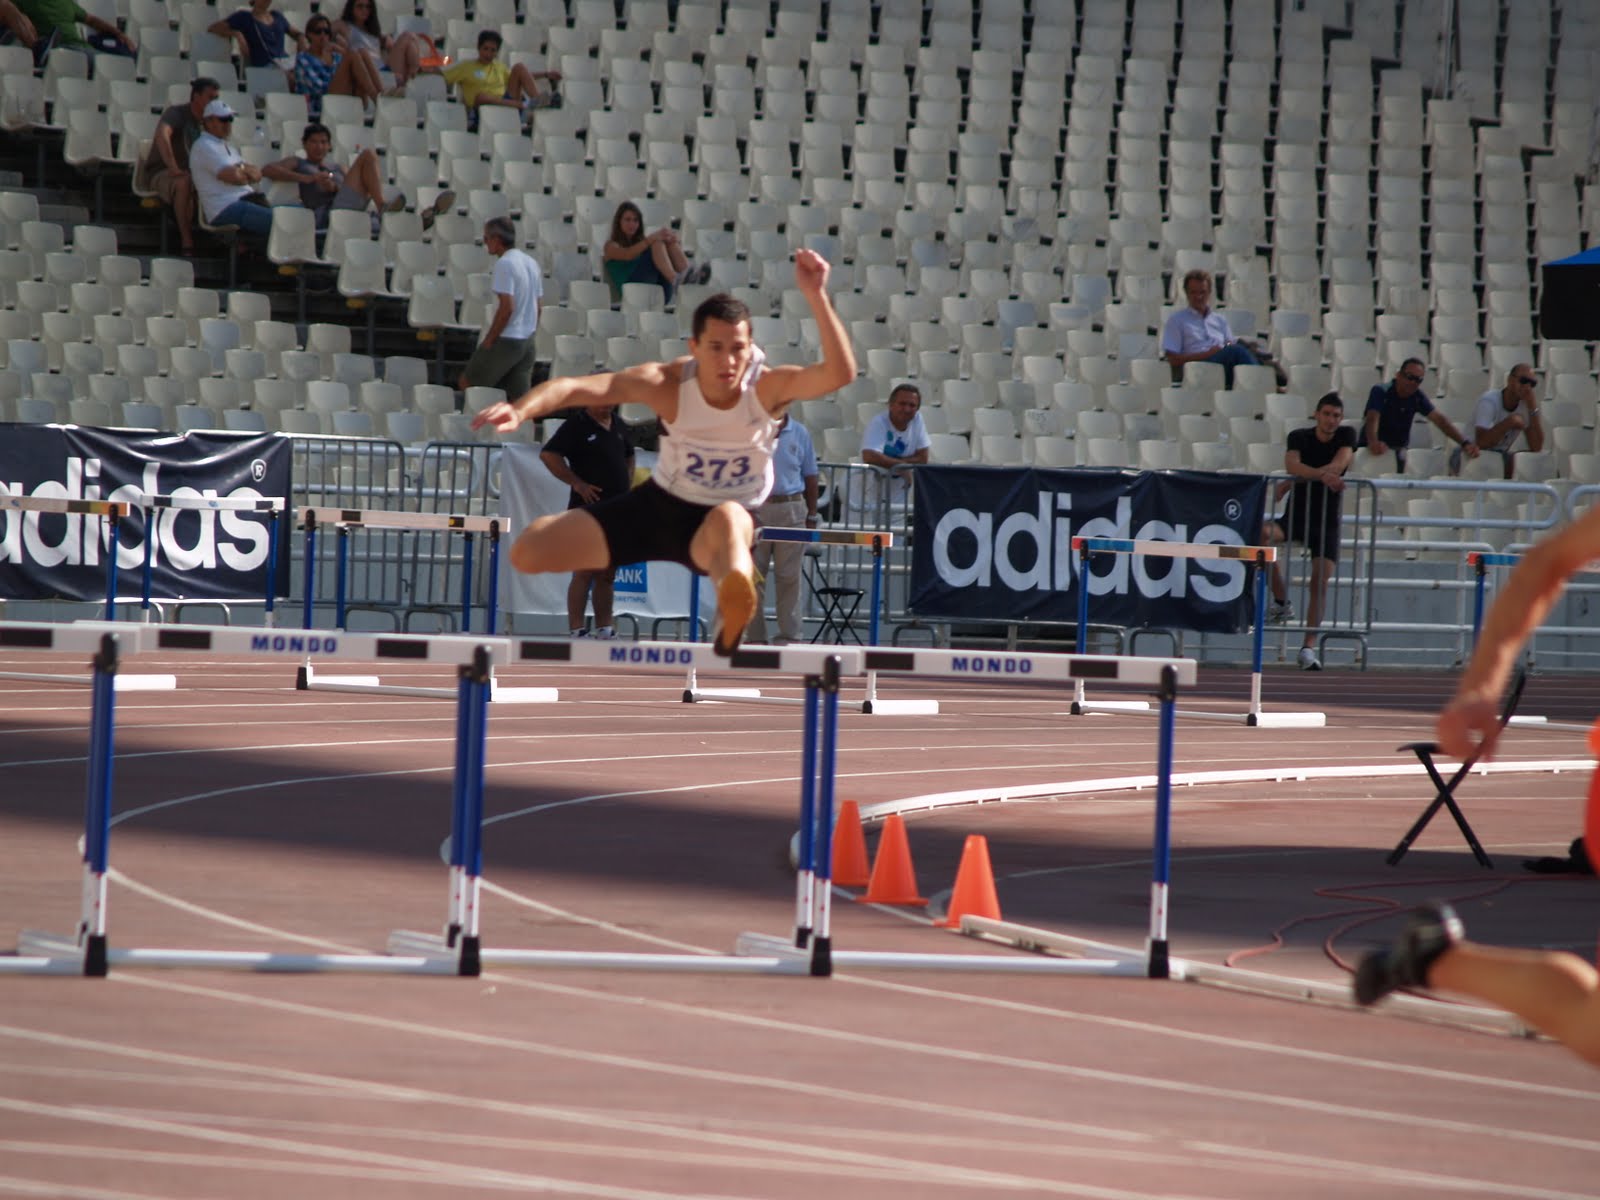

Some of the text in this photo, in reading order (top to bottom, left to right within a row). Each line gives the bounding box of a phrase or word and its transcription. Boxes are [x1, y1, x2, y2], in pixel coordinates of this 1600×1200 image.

[686, 452, 750, 481] 273
[933, 490, 1246, 602] adidas
[252, 635, 337, 653] MONDO
[610, 647, 692, 664] MONDO
[952, 656, 1032, 674] MONDO
